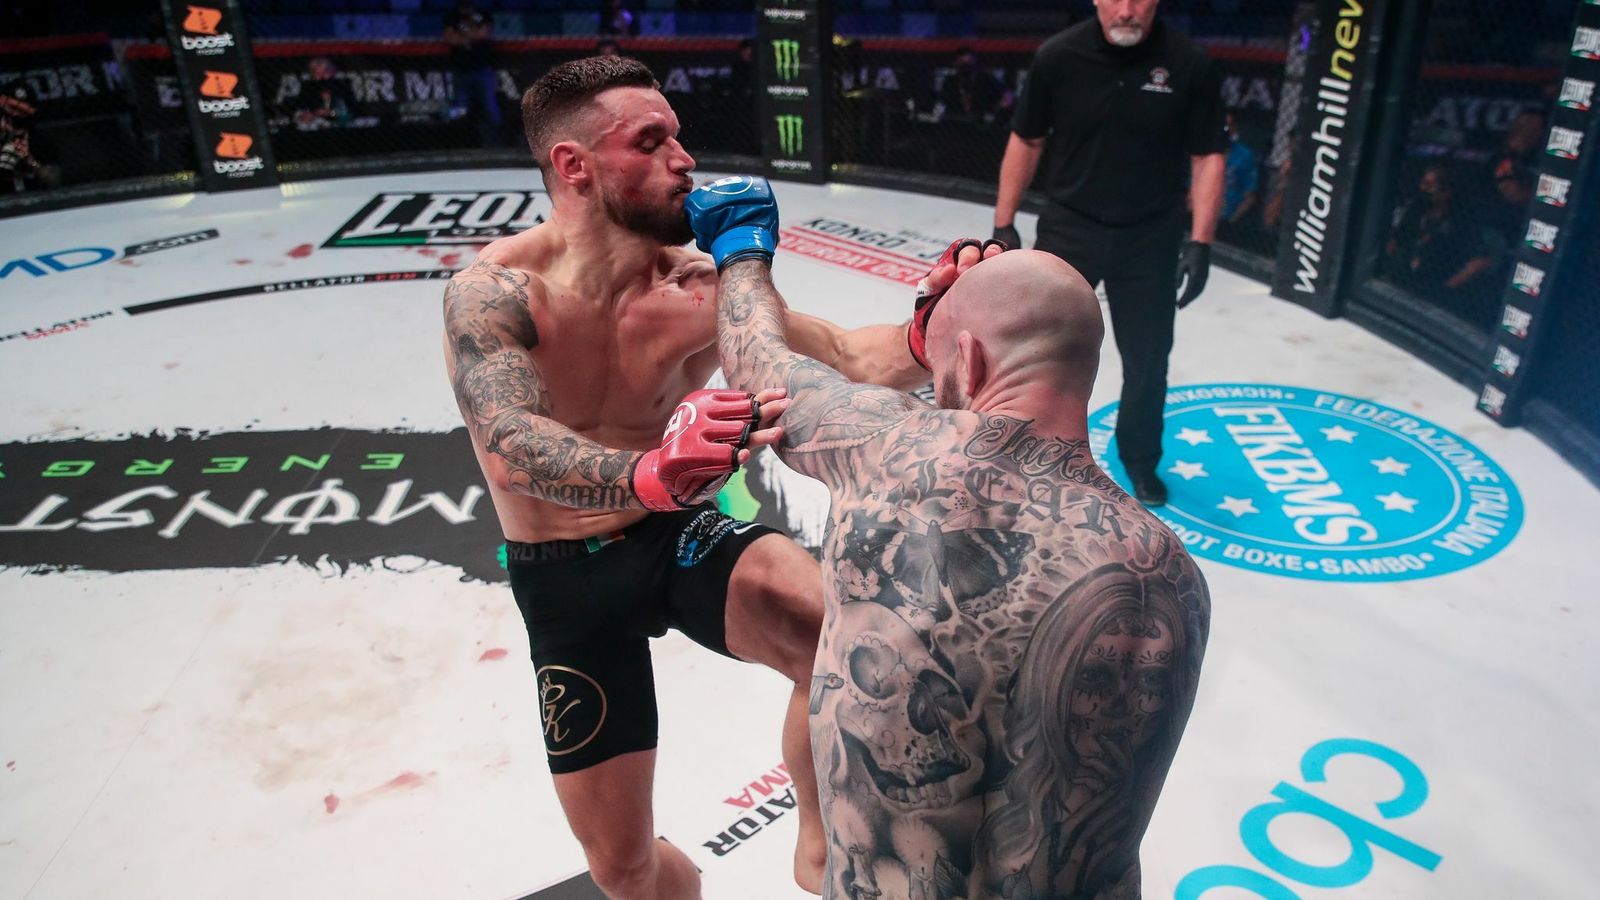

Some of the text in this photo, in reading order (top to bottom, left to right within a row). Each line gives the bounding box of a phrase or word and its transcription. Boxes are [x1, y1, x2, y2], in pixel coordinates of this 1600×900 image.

[181, 32, 235, 50] boost
[198, 96, 250, 113] boost
[213, 157, 264, 173] boost
[1214, 405, 1378, 545] FIKBMS
[1313, 393, 1510, 555] FEDERAZIONE ITALIANA
[1319, 551, 1425, 576] SAMBO
[702, 787, 797, 857] ATOR
